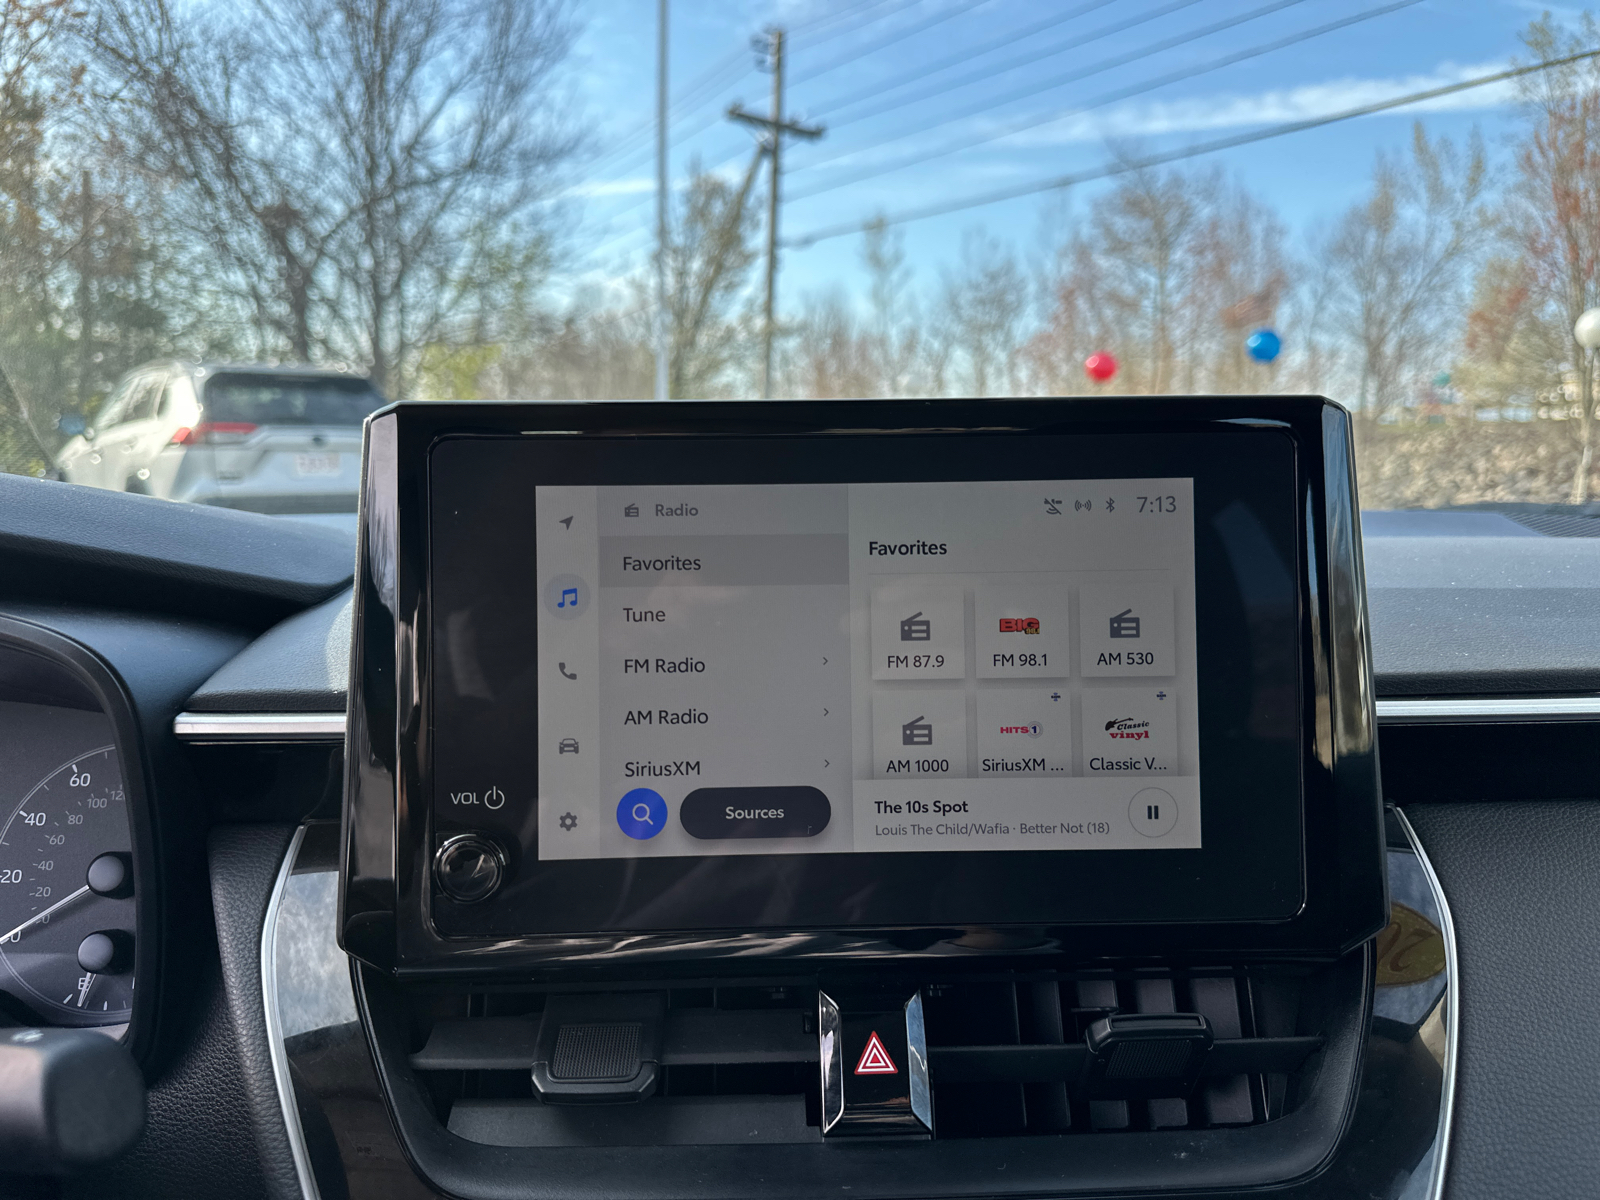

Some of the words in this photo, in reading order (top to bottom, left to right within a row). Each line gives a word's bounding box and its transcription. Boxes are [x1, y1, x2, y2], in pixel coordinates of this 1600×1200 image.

[655, 503, 699, 517] Radio
[1136, 496, 1176, 513] 7:13
[868, 540, 948, 556] Favorites
[622, 555, 702, 571] Favorites
[622, 607, 666, 623] Tune
[999, 618, 1040, 632] BIG
[624, 659, 650, 674] FM
[655, 657, 706, 673] Radio
[887, 656, 909, 669] FM
[913, 655, 945, 668] 87.9
[993, 654, 1014, 667] FM
[1019, 653, 1047, 667] 98.1
[1096, 653, 1121, 666] AM
[1126, 652, 1154, 665] 530
[624, 710, 652, 725] AM
[658, 708, 709, 724] Radio
[1000, 726, 1029, 734] HITS
[1117, 721, 1150, 731] Classic
[1109, 730, 1150, 741] vinyl
[624, 761, 701, 777] SiriusXM
[886, 760, 911, 773] AM
[915, 759, 949, 772] 1000
[982, 758, 1046, 772] SiriusXM
[1089, 757, 1142, 771] Classic
[69, 773, 91, 787] 60
[86, 798, 108, 809] 100
[450, 792, 480, 805] VOL
[725, 806, 785, 820] Sources
[874, 800, 903, 814] The
[905, 800, 929, 814] 10s
[933, 800, 969, 817] Spot
[24, 812, 46, 827] 40
[67, 814, 84, 825] 80
[875, 824, 908, 836] Louis
[910, 824, 933, 836] The
[936, 822, 1010, 837] Child/Wafia
[1020, 822, 1057, 834] Better
[1060, 822, 1084, 834] Not
[1087, 822, 1110, 835] (18)
[49, 834, 65, 845] 60
[37, 860, 54, 871] 40
[0, 869, 22, 884] 20
[35, 886, 51, 897] 20
